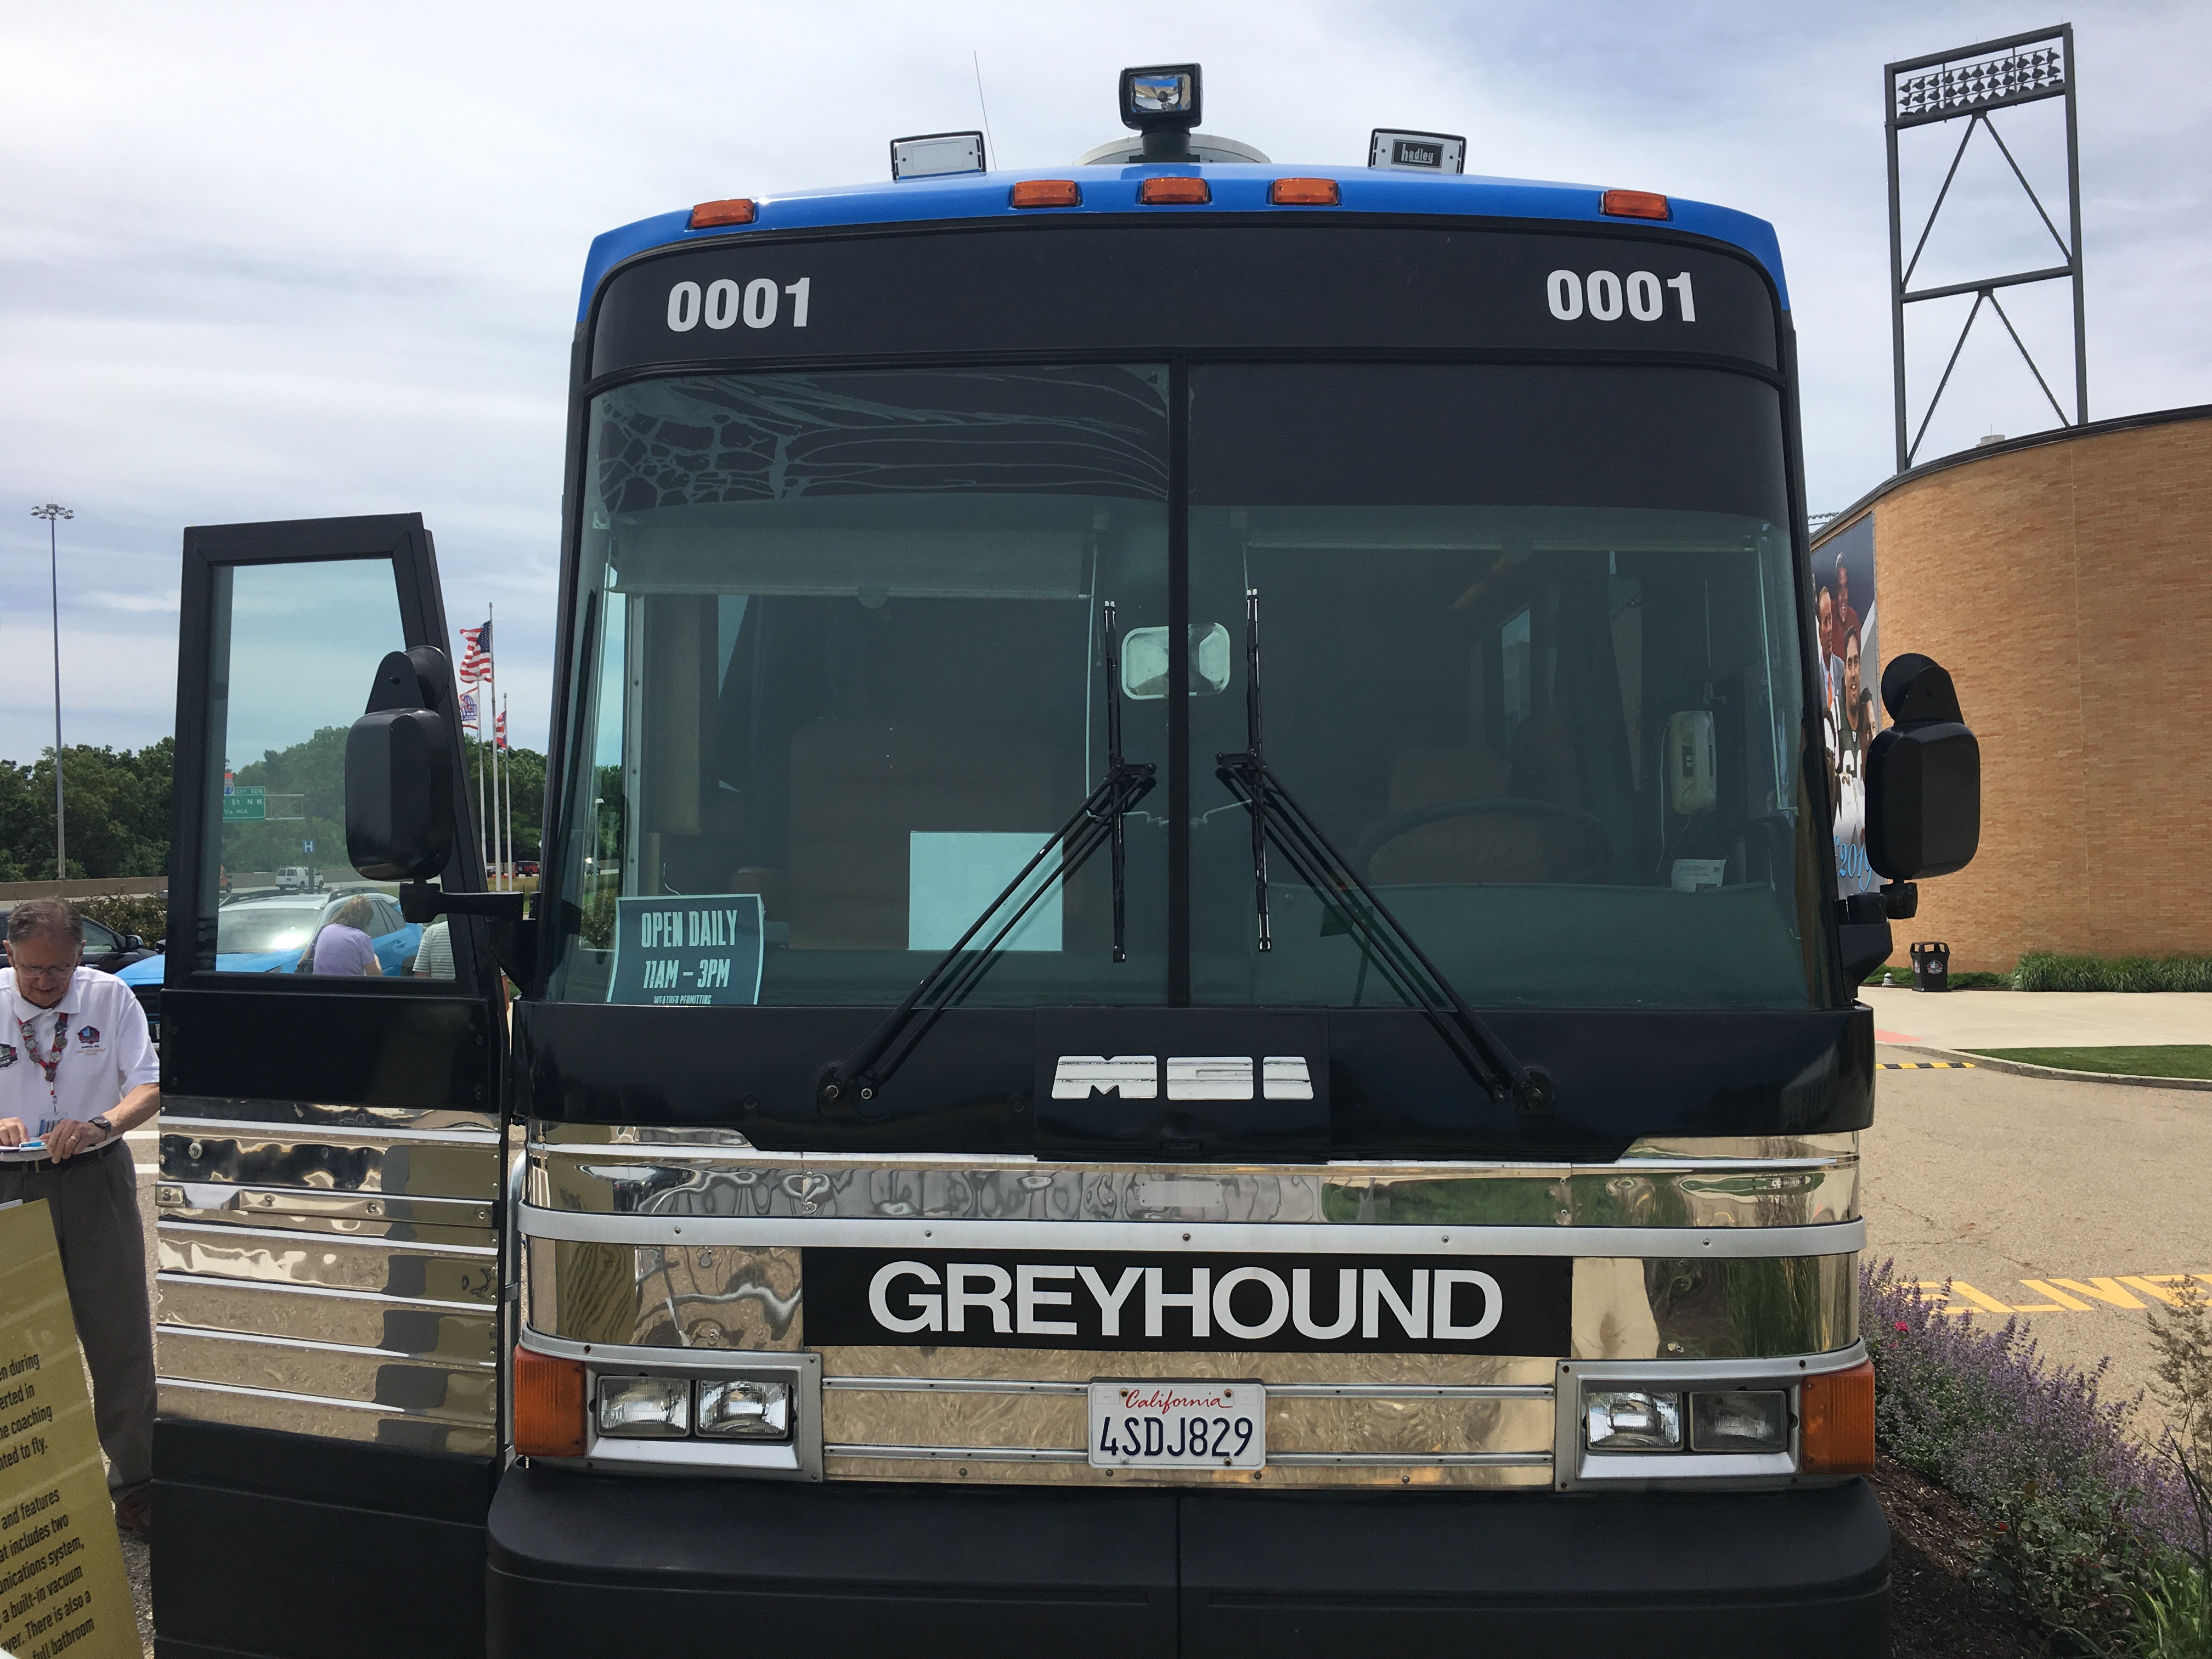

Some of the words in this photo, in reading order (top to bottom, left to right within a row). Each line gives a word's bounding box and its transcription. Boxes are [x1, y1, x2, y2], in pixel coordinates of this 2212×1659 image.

[1401, 144, 1434, 164] hadley
[667, 277, 810, 332] 0001
[1547, 269, 1696, 322] 0001
[304, 840, 313, 852] H
[641, 911, 683, 947] OPEN
[689, 910, 737, 946] DAILY
[643, 960, 679, 989] 11AM
[697, 958, 730, 988] 3PM
[653, 995, 679, 1004] WEATHER
[679, 994, 712, 1005] PERMITTING
[868, 1261, 1503, 1340] GREYHOUND
[9, 1353, 41, 1376] during
[25, 1383, 36, 1400] in
[1125, 1389, 1233, 1415] California
[11, 1406, 53, 1435] coaching
[1099, 1416, 1253, 1457] 4SDJ829
[20, 1444, 31, 1459] to
[31, 1436, 48, 1455] fly.
[1, 1506, 20, 1530] and
[20, 1489, 60, 1521] features
[9, 1524, 50, 1557] includes
[51, 1514, 70, 1533] two
[48, 1536, 84, 1567] system,
[2, 1609, 10, 1623] a
[9, 1587, 46, 1618] built-in
[47, 1565, 83, 1596] vacuum
[25, 1614, 53, 1640] There
[53, 1606, 64, 1623] is
[64, 1594, 84, 1617] also
[84, 1590, 92, 1604] a
[50, 1617, 95, 1656] bathroom
